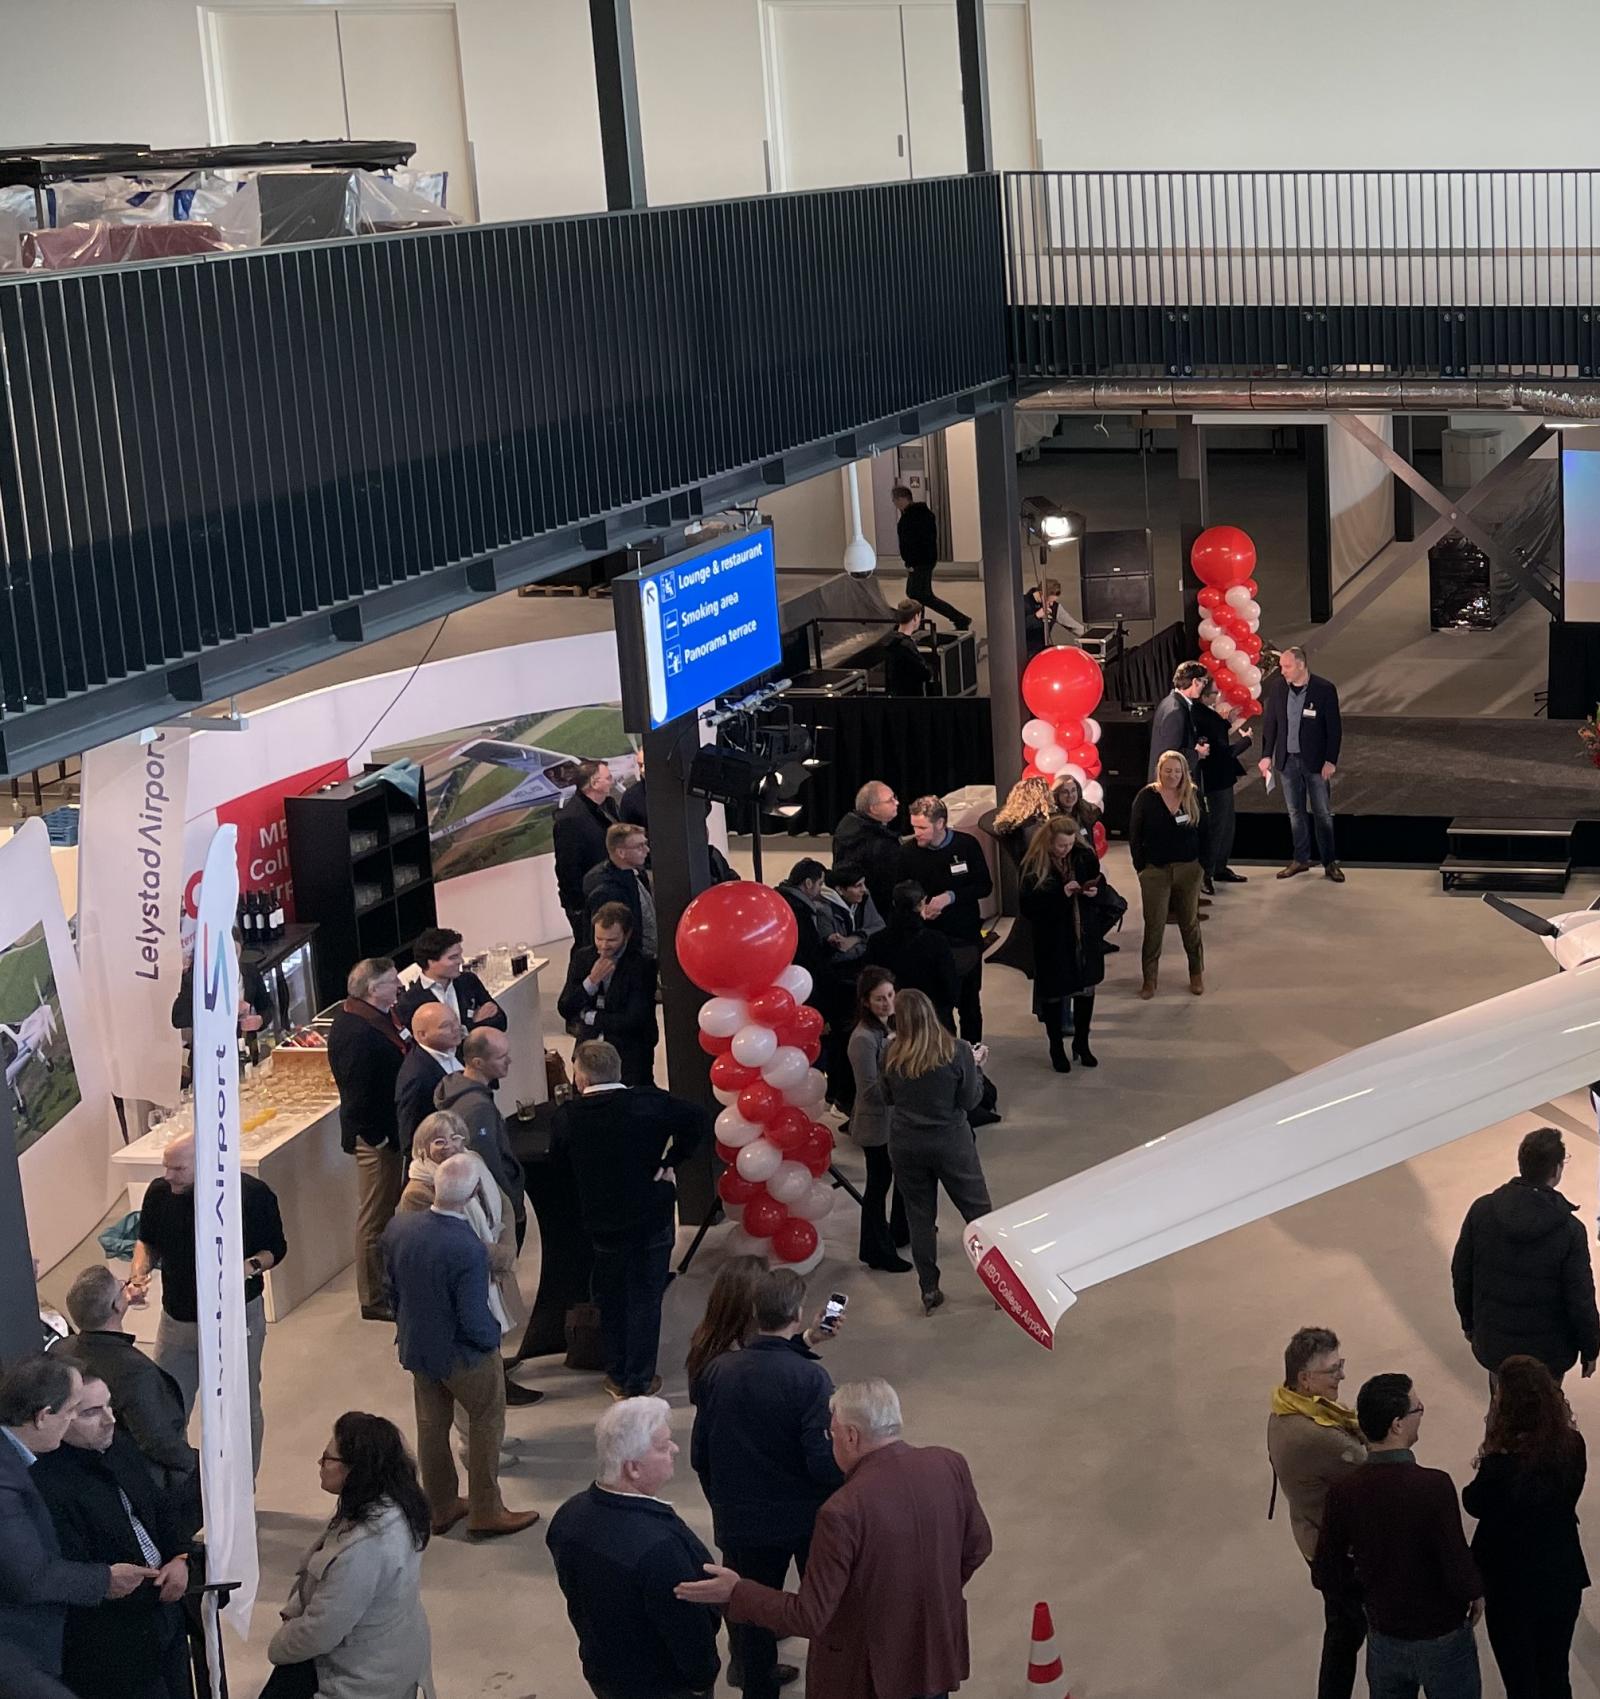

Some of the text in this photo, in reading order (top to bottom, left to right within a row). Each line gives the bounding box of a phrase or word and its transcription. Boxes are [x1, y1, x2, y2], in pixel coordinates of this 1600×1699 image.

[678, 543, 763, 590] Lounge & restaurant
[681, 592, 739, 627] Smoking area
[684, 619, 757, 664] Panorama terrace
[259, 818, 288, 849] MB
[249, 847, 290, 881] Coll
[135, 847, 165, 981] Lelystad
[984, 1259, 1047, 1341] MBO College Airport
